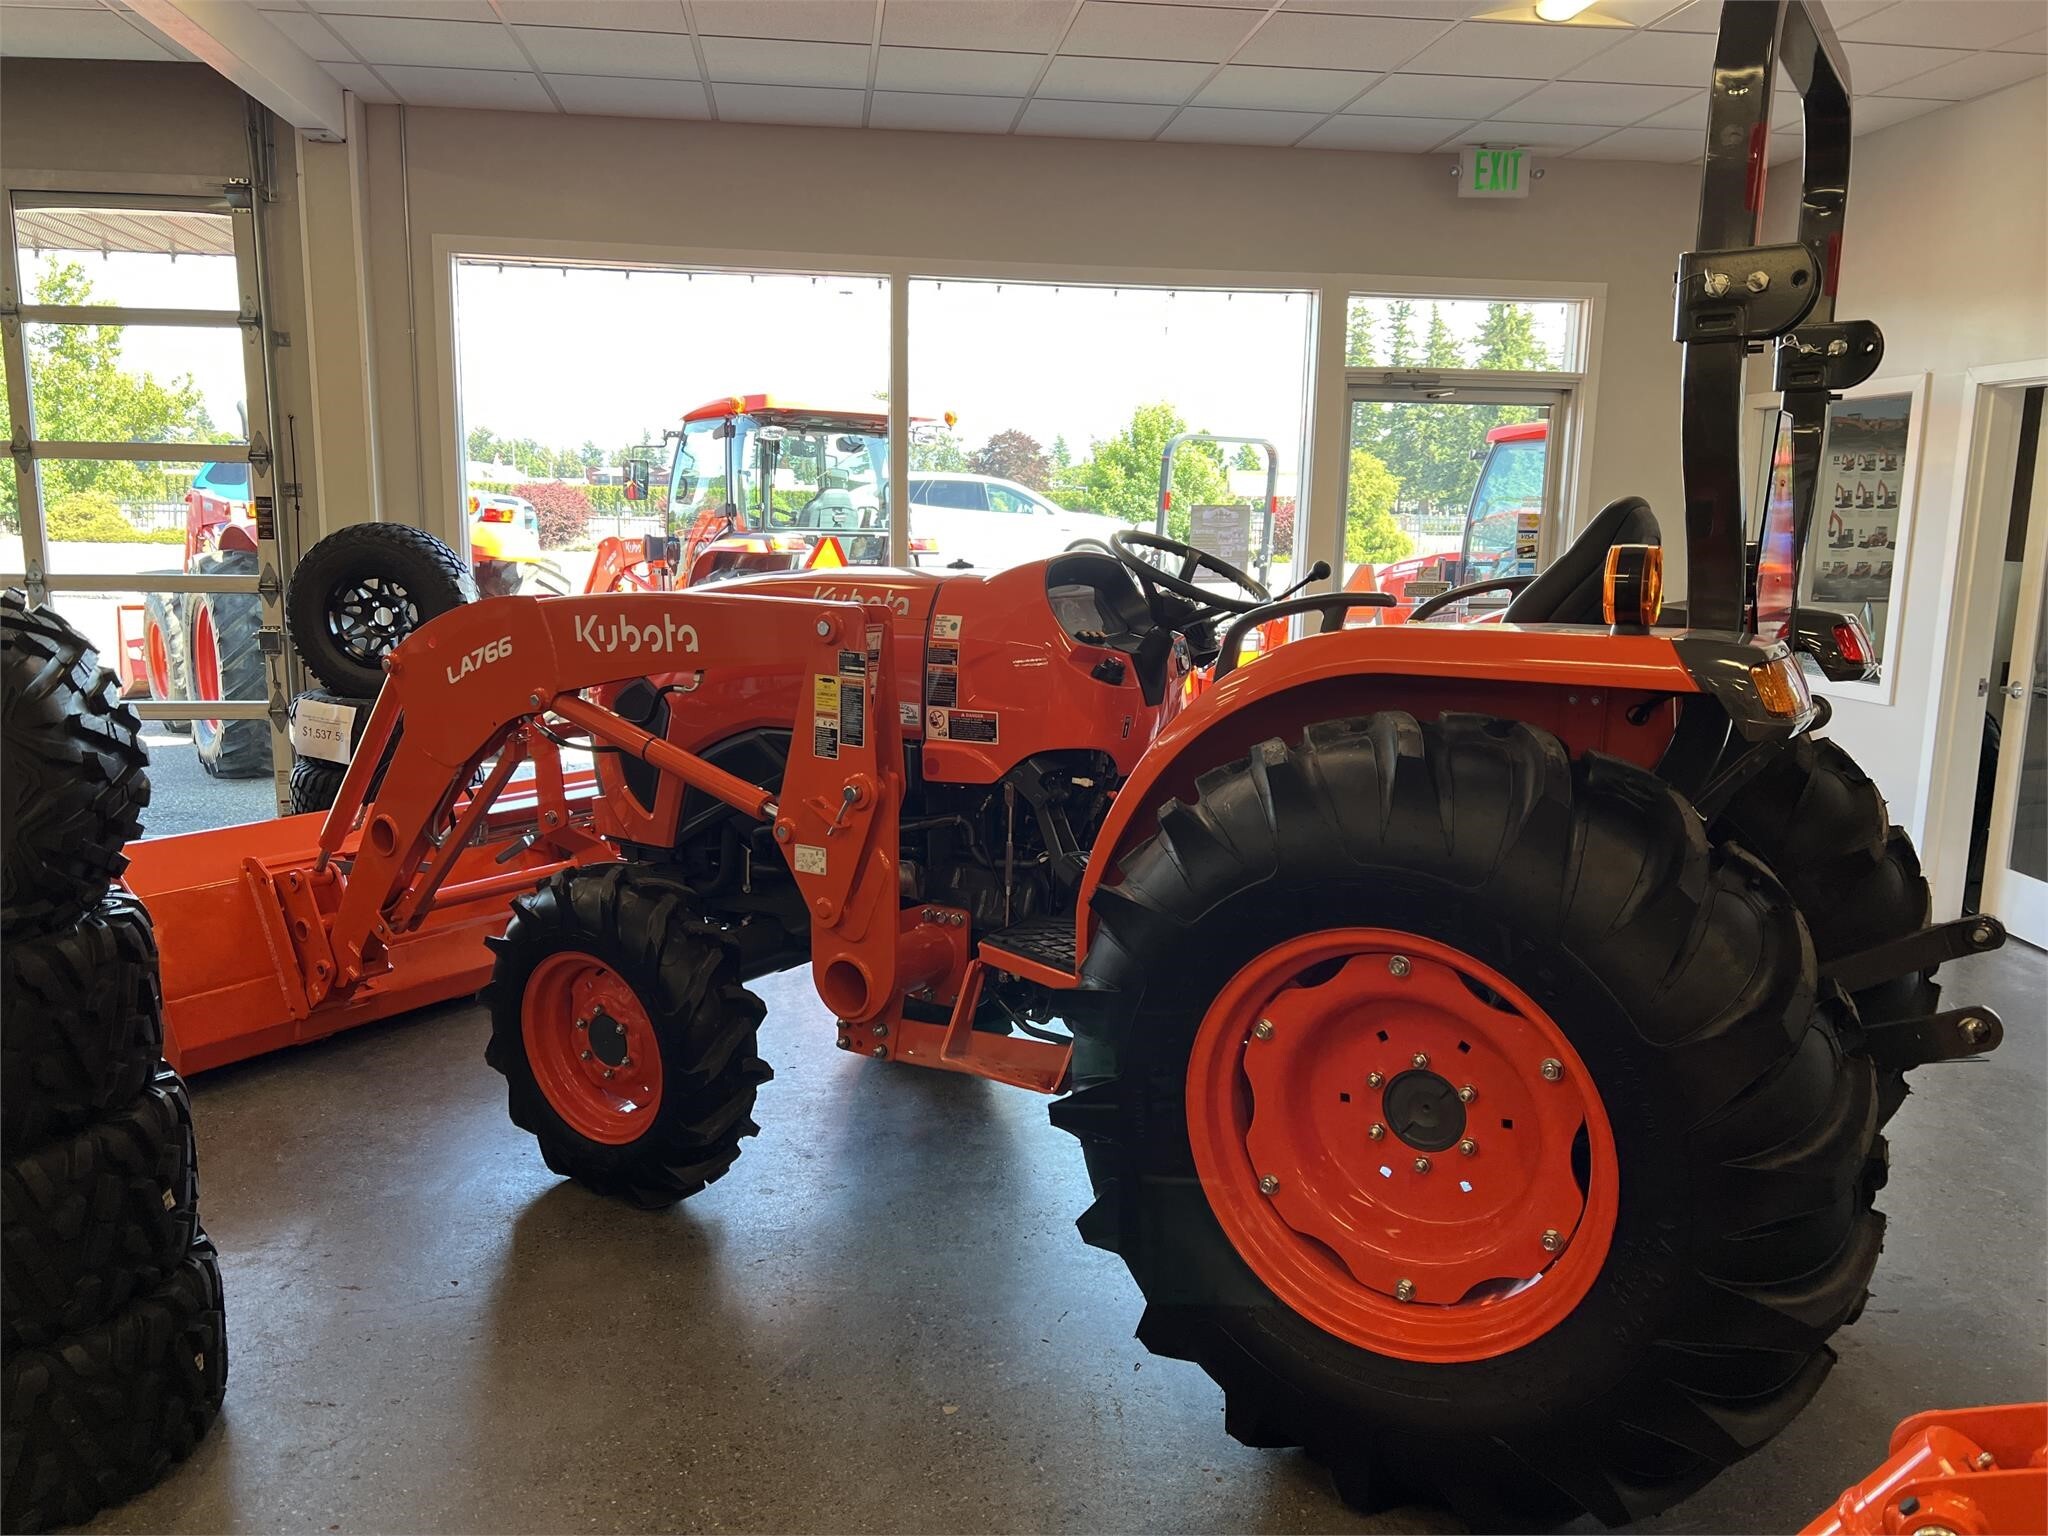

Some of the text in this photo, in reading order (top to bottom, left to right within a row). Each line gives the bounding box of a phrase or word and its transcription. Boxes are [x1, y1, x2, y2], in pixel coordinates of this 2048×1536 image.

[1474, 151, 1521, 190] EXIT
[575, 613, 699, 652] Kubota
[446, 636, 513, 684] LA766
[302, 726, 344, 742] $1,5375
